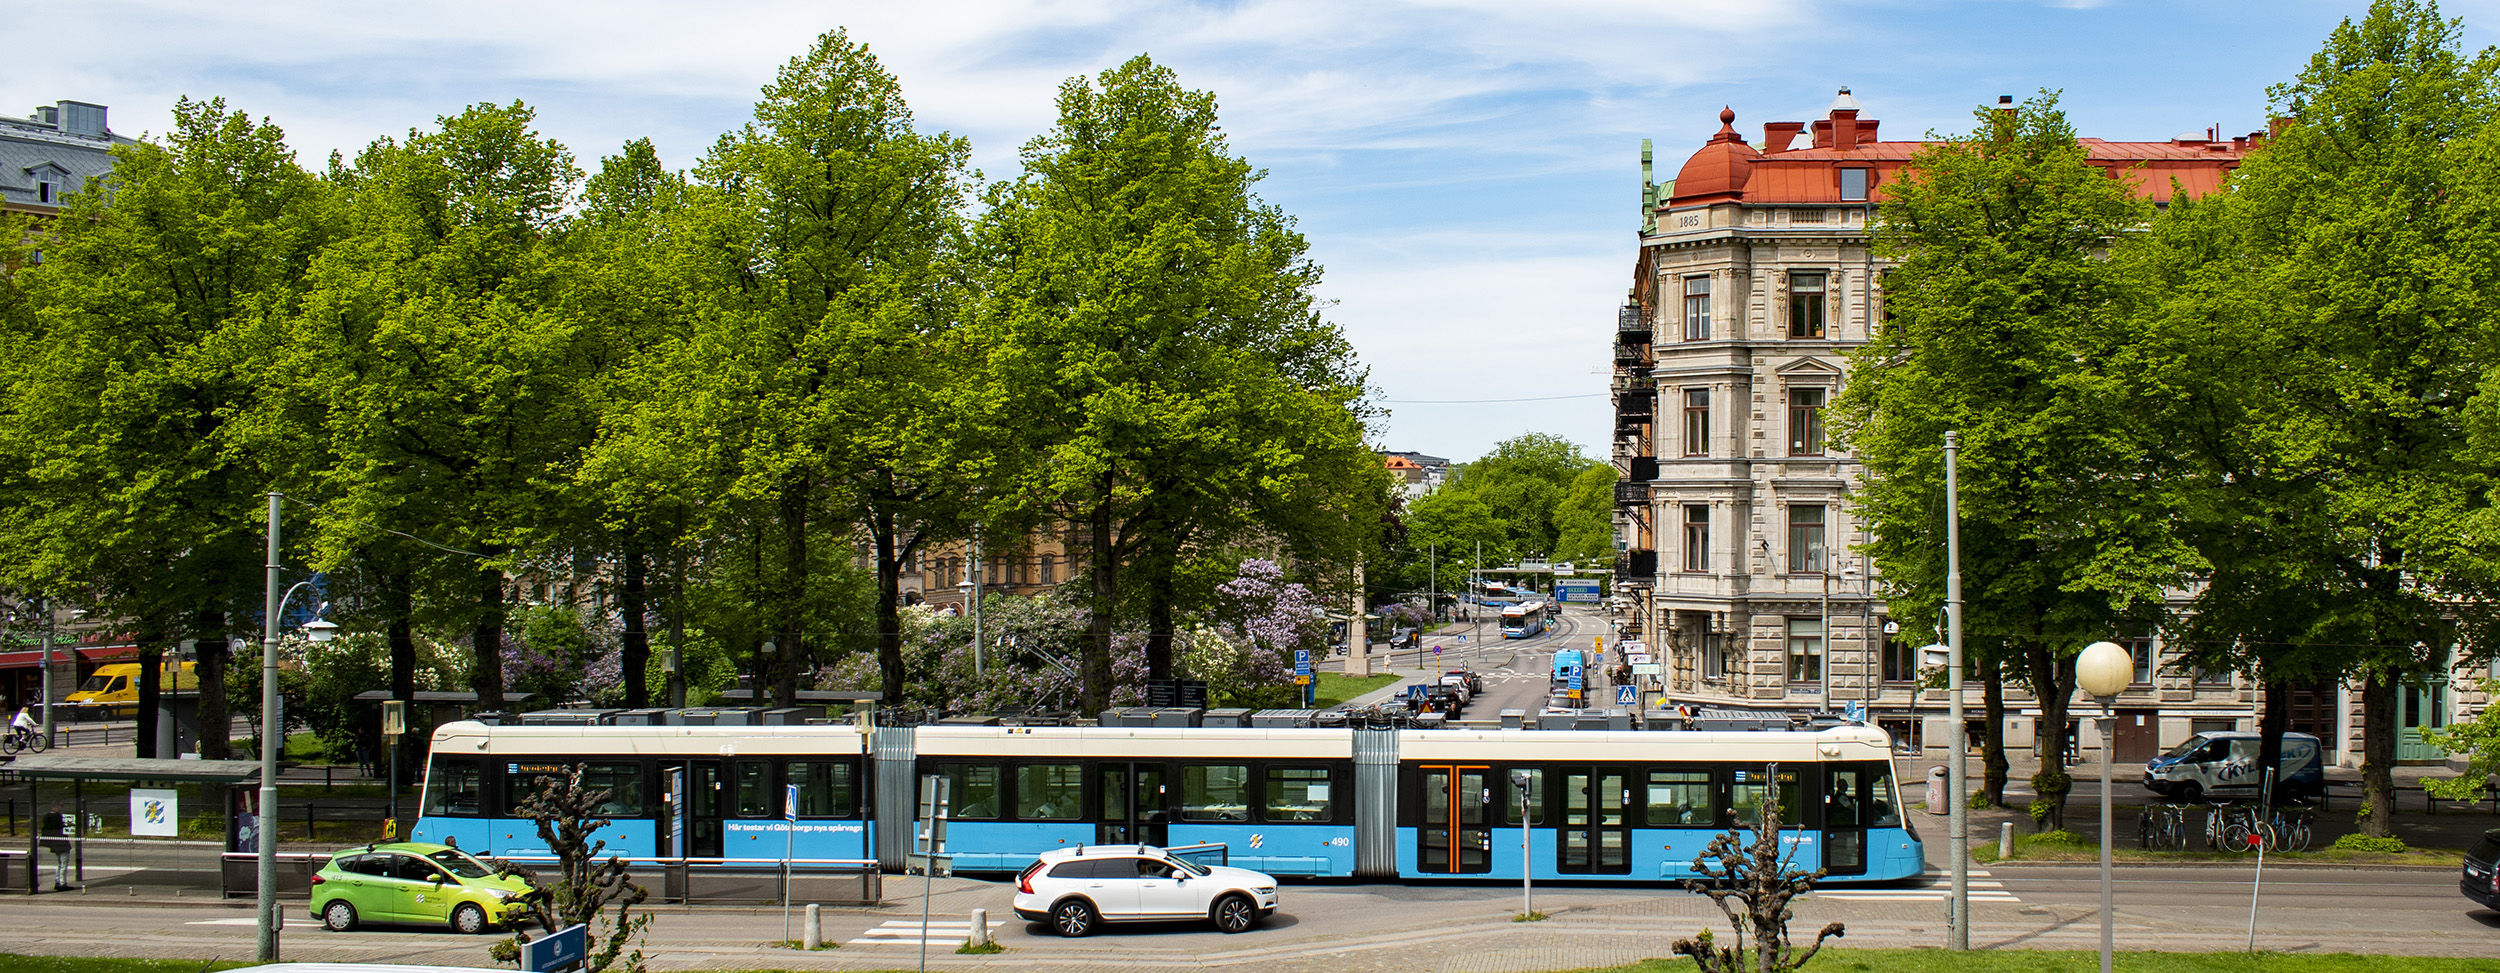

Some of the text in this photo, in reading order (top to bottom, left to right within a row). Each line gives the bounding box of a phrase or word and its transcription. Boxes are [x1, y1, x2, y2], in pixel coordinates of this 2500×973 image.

[1680, 215, 1699, 228] 1885
[1299, 651, 1306, 661] P
[1573, 666, 1580, 676] P
[728, 823, 743, 831] Här
[774, 823, 813, 832] Götborgs
[828, 823, 863, 832] spårvagn
[1331, 837, 1349, 847] 490
